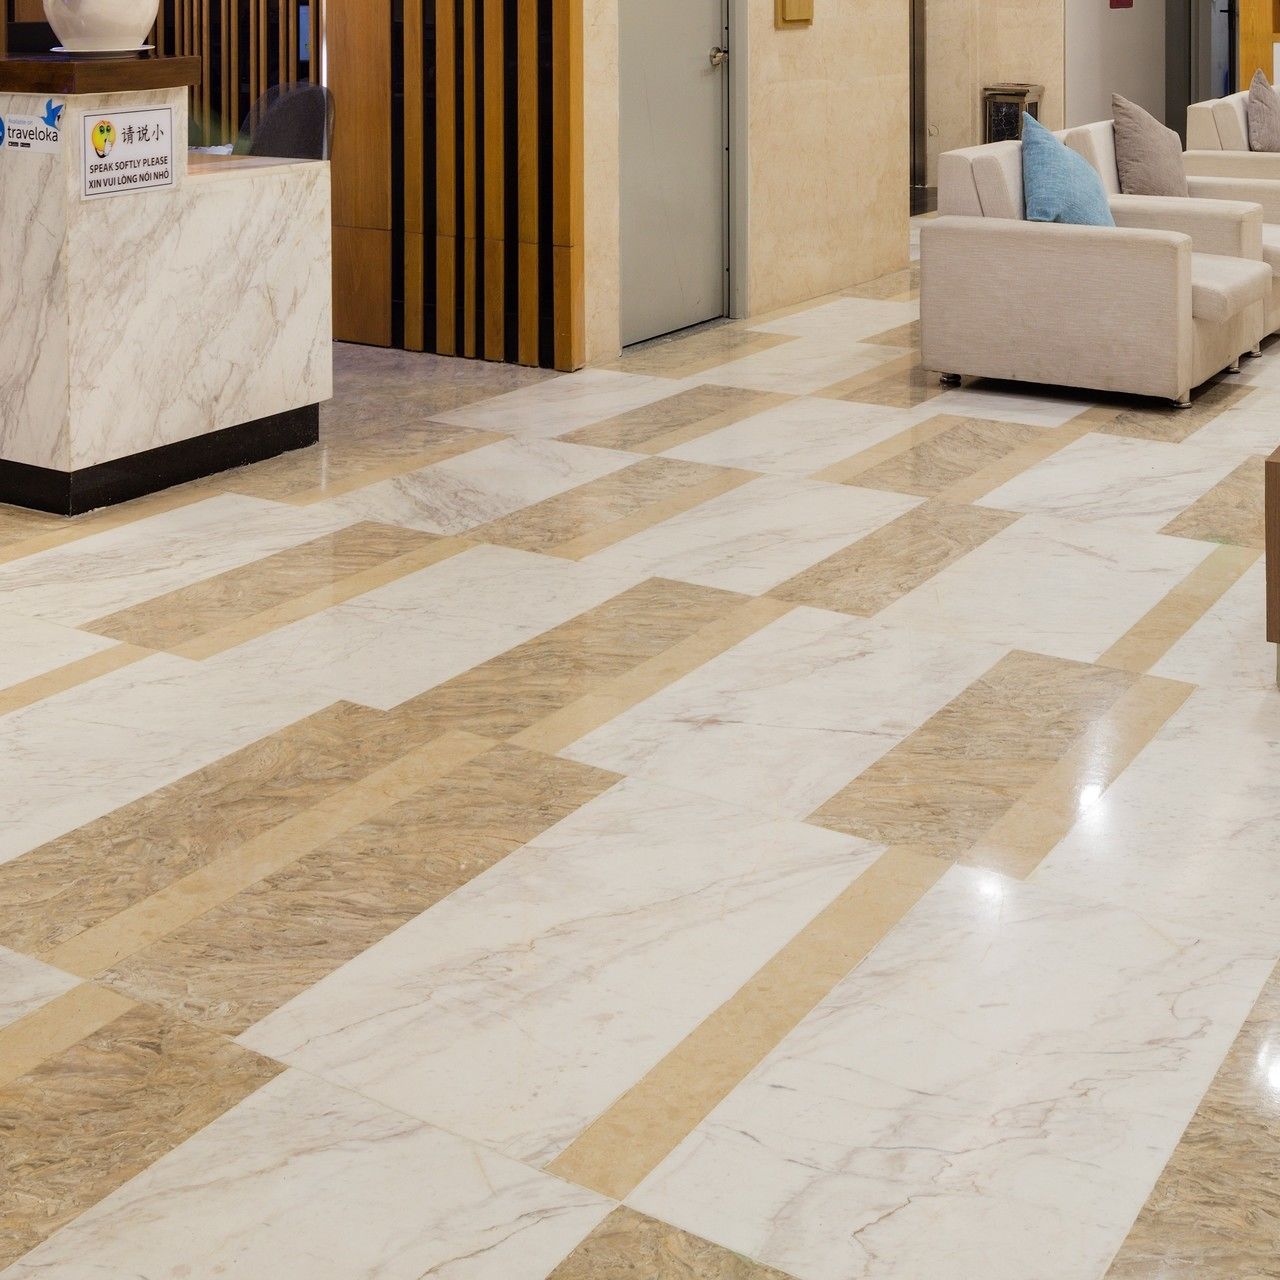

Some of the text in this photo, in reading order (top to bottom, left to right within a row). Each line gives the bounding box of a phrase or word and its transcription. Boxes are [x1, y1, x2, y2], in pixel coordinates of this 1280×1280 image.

[7, 126, 59, 142] traveloka
[89, 156, 168, 174] SPEAK SOFTLY PLEASE
[88, 179, 102, 189] XIN
[103, 177, 116, 187] VUI
[117, 173, 138, 185] LÒNG
[139, 171, 152, 182] NÓI
